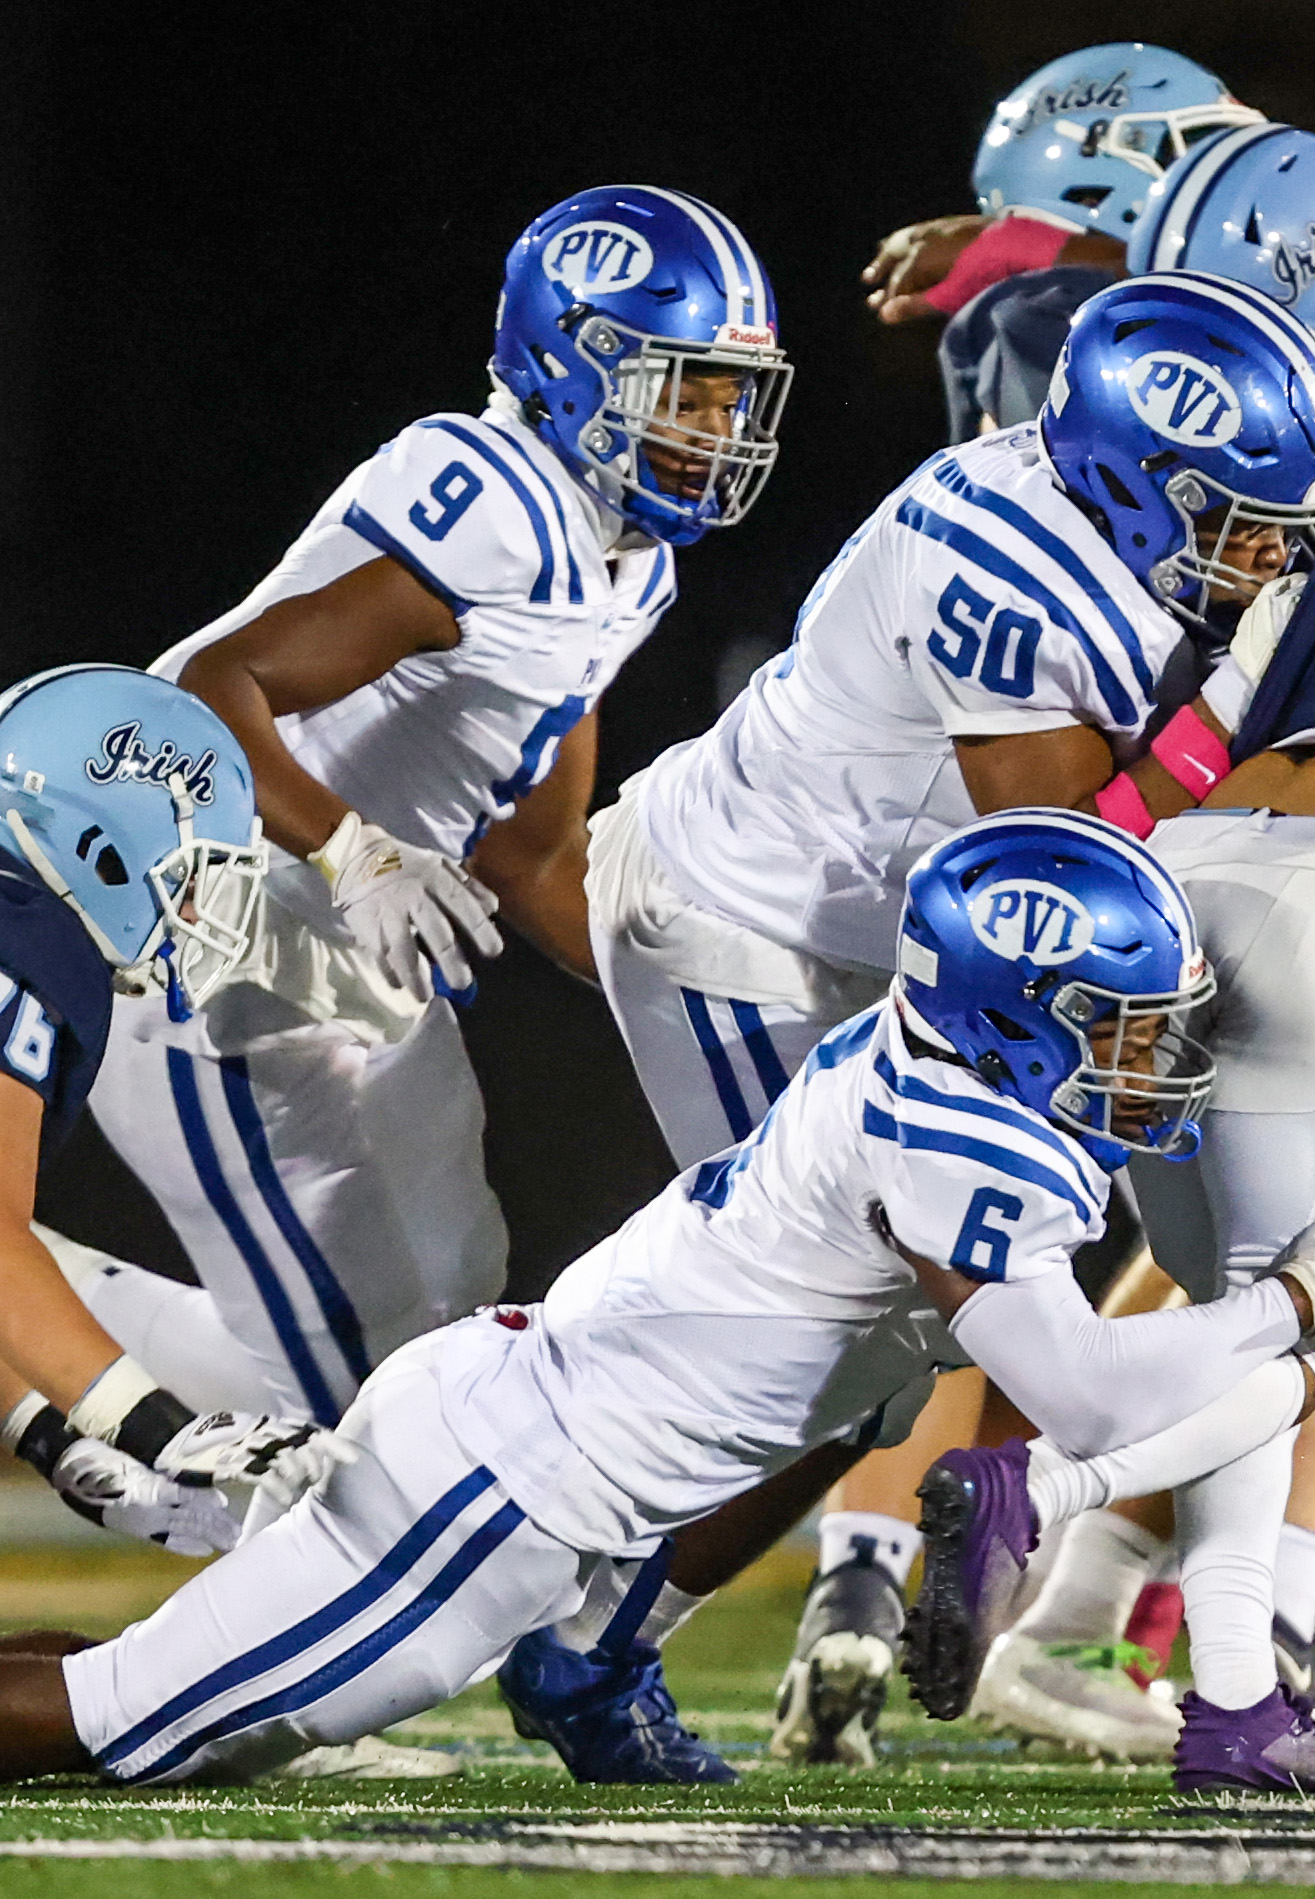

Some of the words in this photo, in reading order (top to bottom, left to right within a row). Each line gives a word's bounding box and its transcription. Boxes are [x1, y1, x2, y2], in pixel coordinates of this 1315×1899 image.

[551, 229, 642, 284] PVI
[1136, 361, 1234, 437] PVI
[409, 461, 484, 541] 9
[927, 573, 1043, 699] 50
[85, 719, 219, 806] Irish
[982, 890, 1080, 953] PVI
[950, 1186, 1024, 1283] 6
